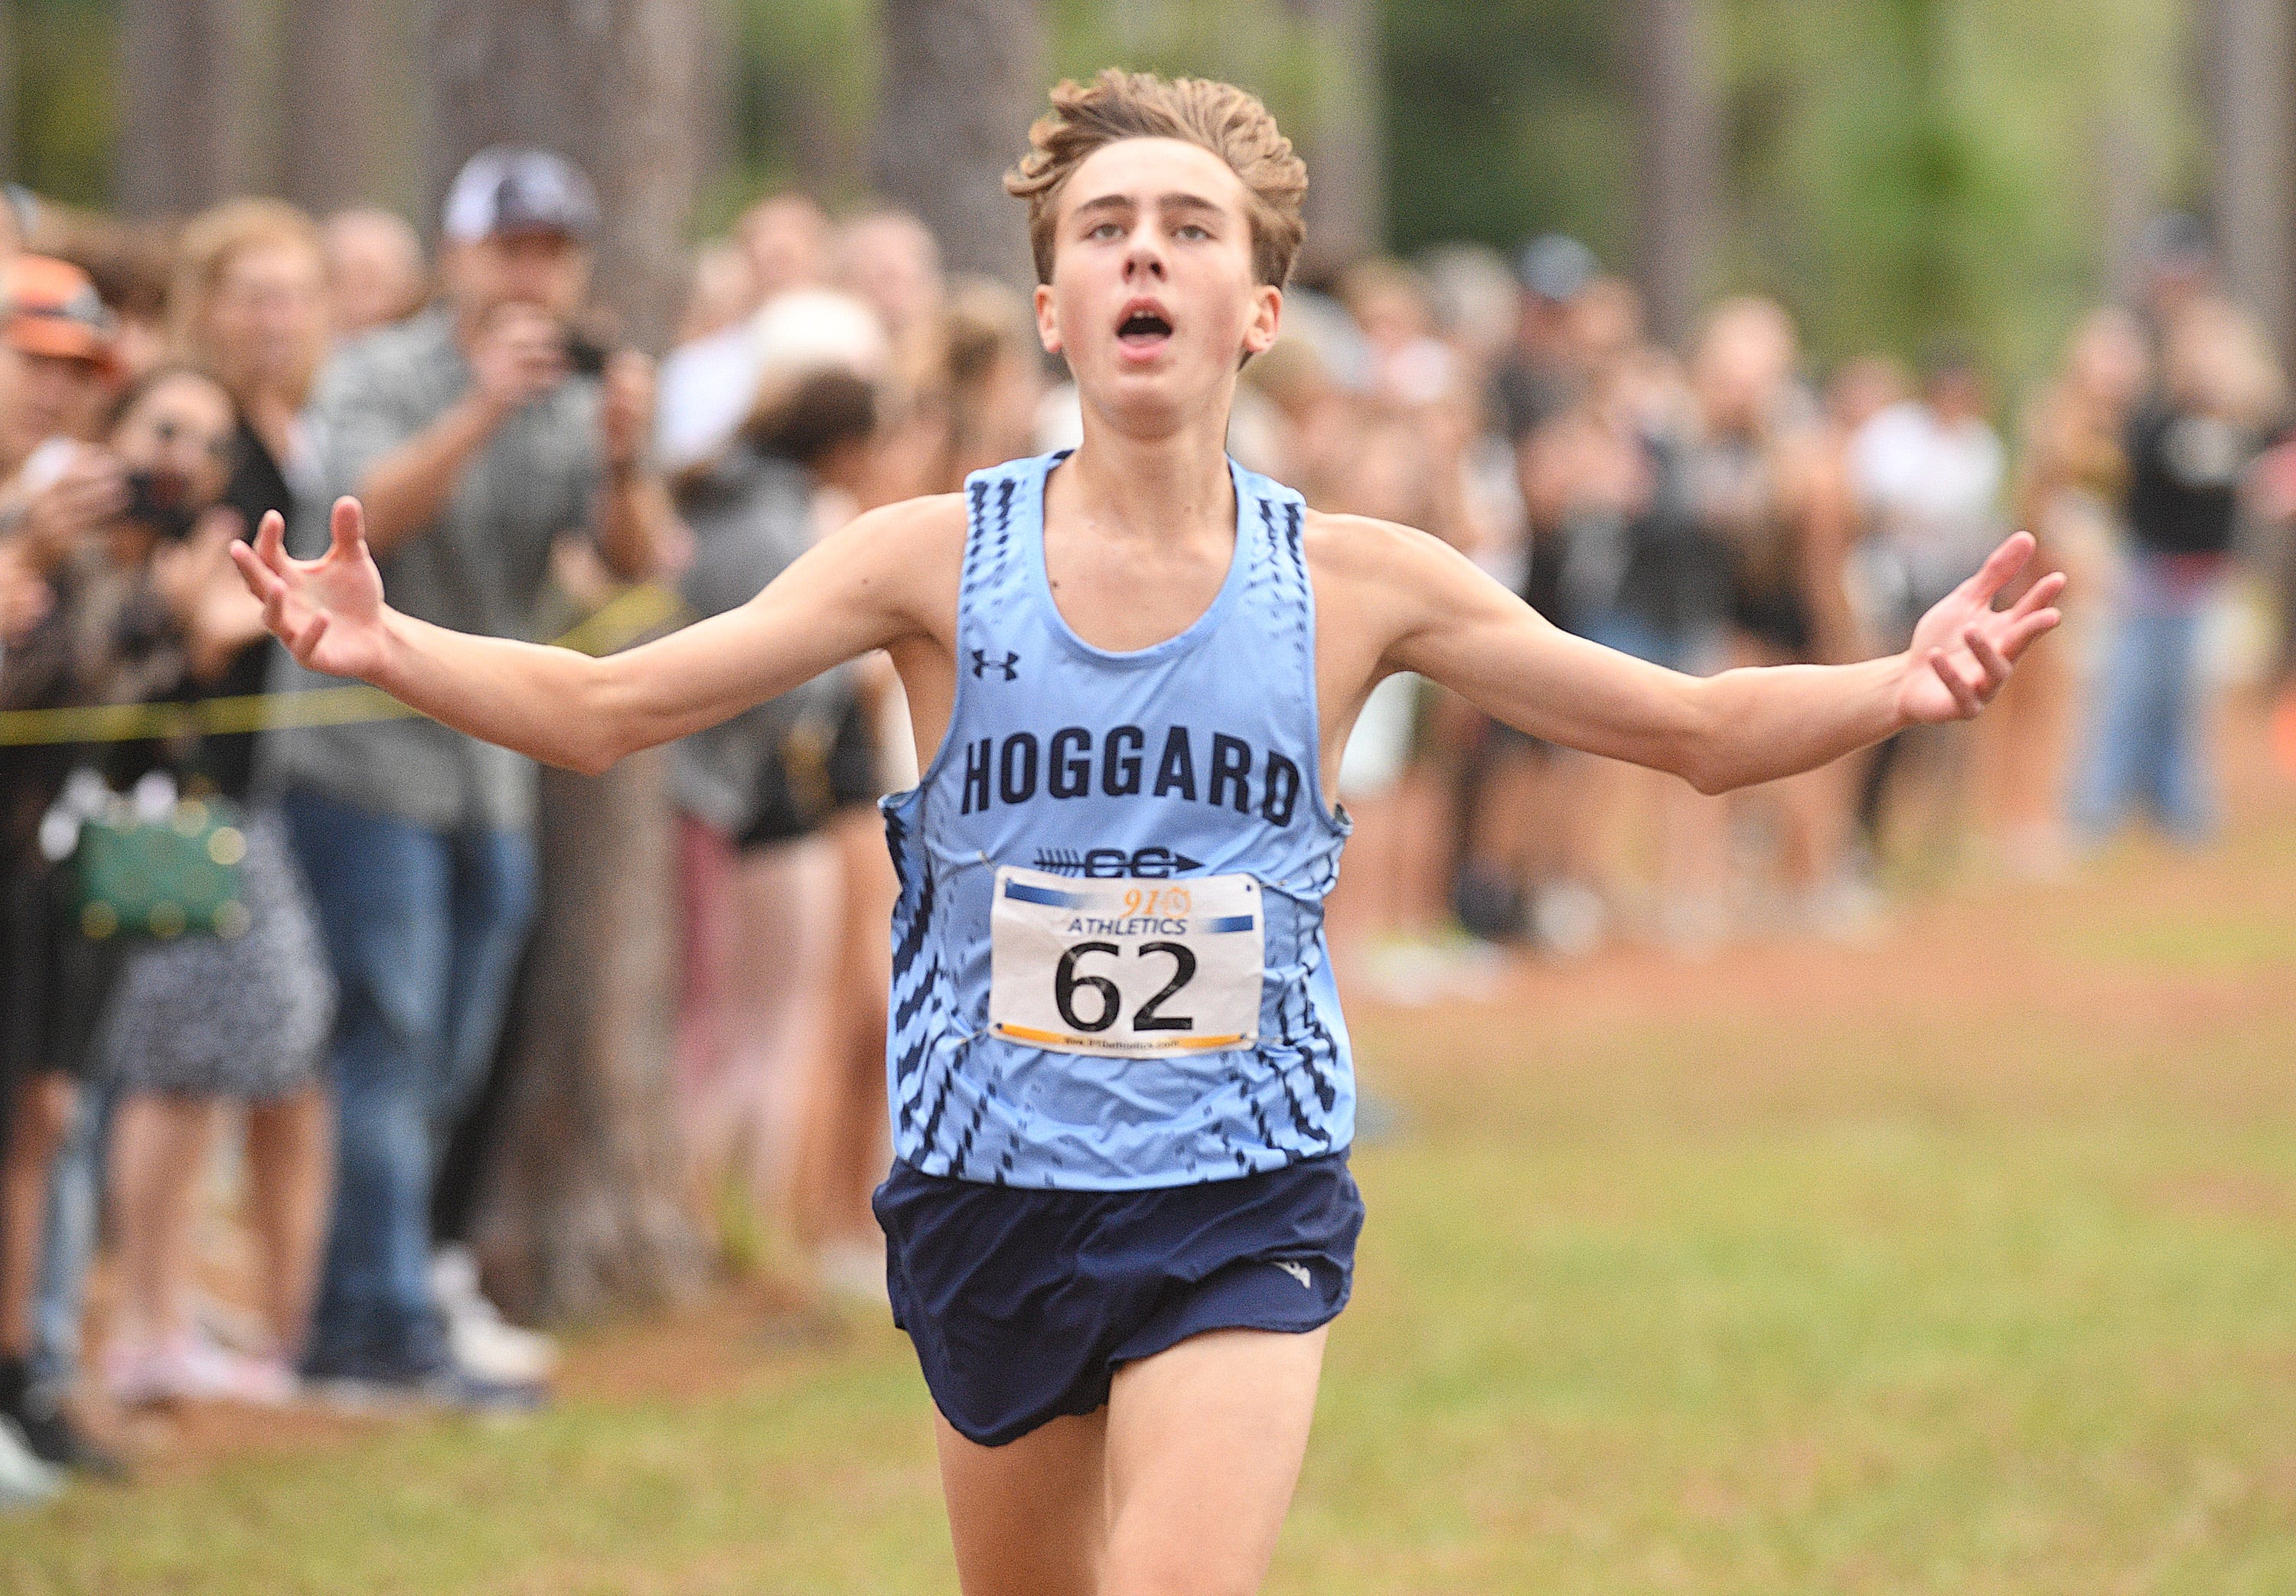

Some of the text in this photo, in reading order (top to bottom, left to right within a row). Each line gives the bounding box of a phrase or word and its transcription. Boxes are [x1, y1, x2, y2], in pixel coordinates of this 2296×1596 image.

[962, 725, 1300, 827] HOGGARD
[1068, 917, 1187, 935] ATHLETICS
[1055, 941, 1196, 1032] 62
